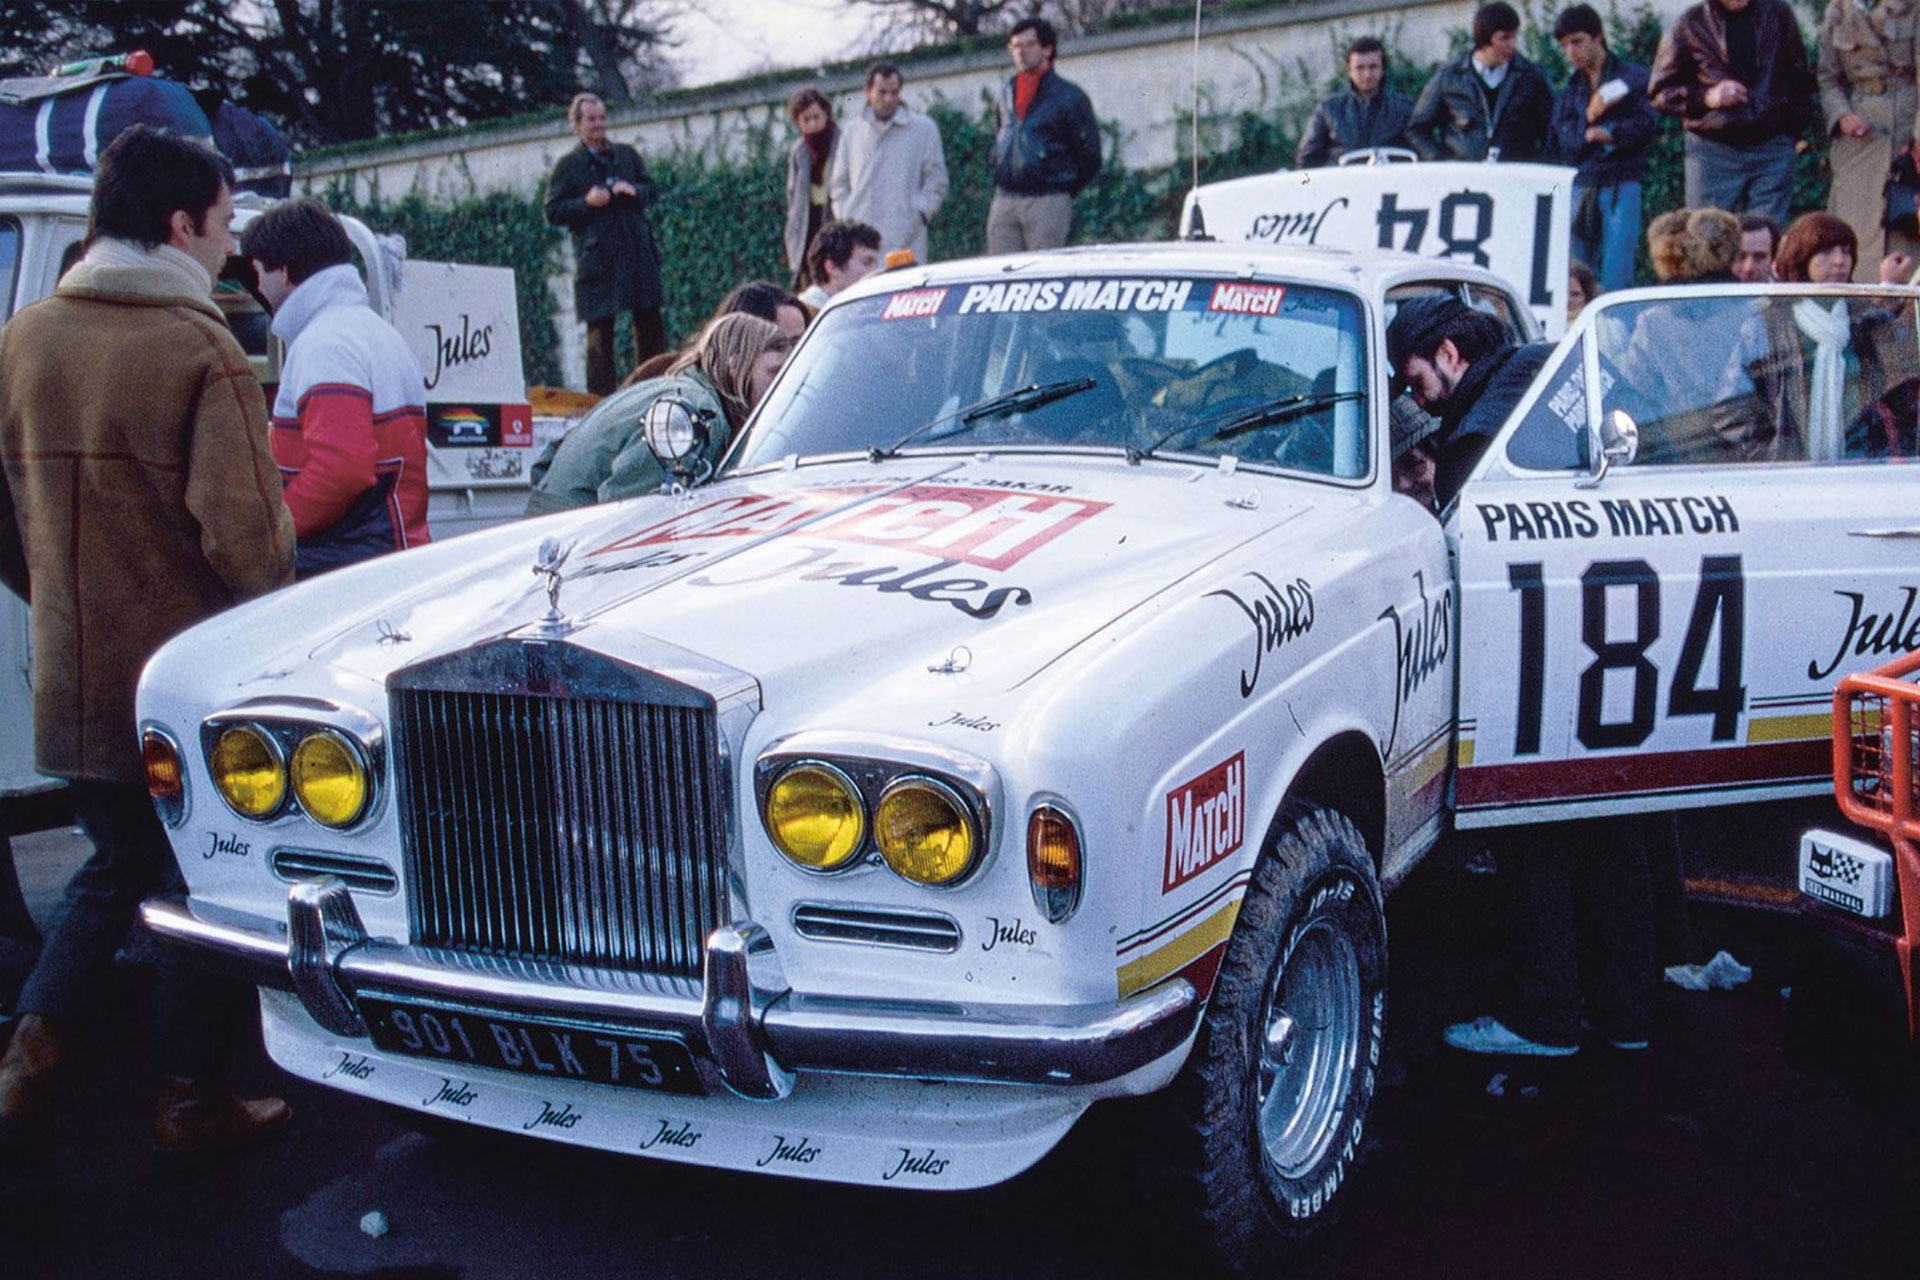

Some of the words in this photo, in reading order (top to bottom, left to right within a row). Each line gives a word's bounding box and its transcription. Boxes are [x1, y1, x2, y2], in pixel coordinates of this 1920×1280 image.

[884, 288, 947, 319] MATCH
[958, 280, 1063, 314] PARIS
[1060, 280, 1193, 311] MATCH
[1212, 283, 1282, 314] MATCH
[424, 314, 493, 391] Jules
[1476, 500, 1599, 542] PARIS
[1600, 495, 1740, 537] MATCH
[687, 546, 1032, 619] Jules
[1201, 571, 1314, 698] Jules
[1377, 570, 1451, 764] Jules
[1508, 554, 1746, 756] 184
[928, 711, 1001, 732] Jules
[203, 831, 251, 860] Jules
[1168, 760, 1241, 885] MATCH
[982, 916, 1037, 951] Jules
[391, 1009, 476, 1059] 901
[596, 1038, 664, 1084] 75
[323, 1052, 375, 1079] Jules
[423, 1078, 478, 1107] Jules
[524, 1101, 582, 1129] Jules
[640, 1119, 702, 1149] Jules
[757, 1135, 821, 1167] Jules
[882, 1147, 950, 1181] Jules
